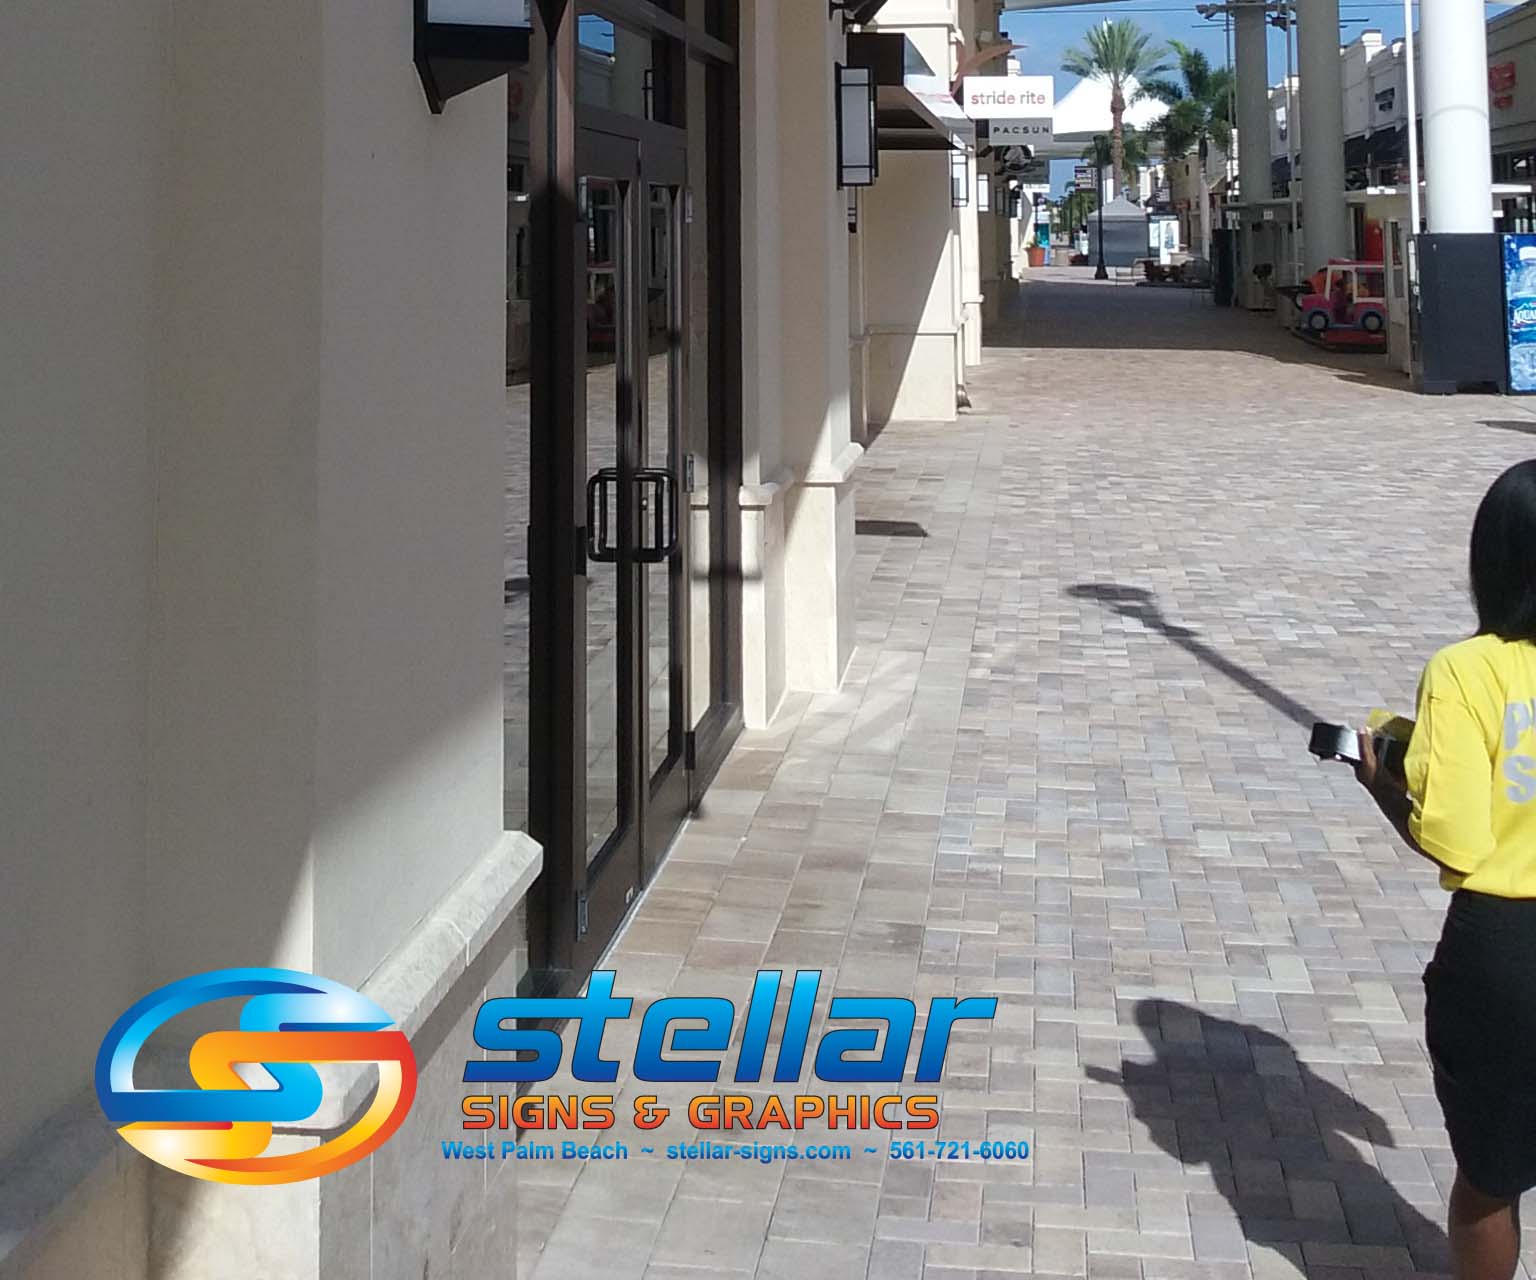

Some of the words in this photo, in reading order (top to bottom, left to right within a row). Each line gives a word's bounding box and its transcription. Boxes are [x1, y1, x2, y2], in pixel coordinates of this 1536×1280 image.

[971, 90, 1016, 105] stride
[1020, 91, 1046, 105] rite
[993, 126, 1050, 135] PACSUN
